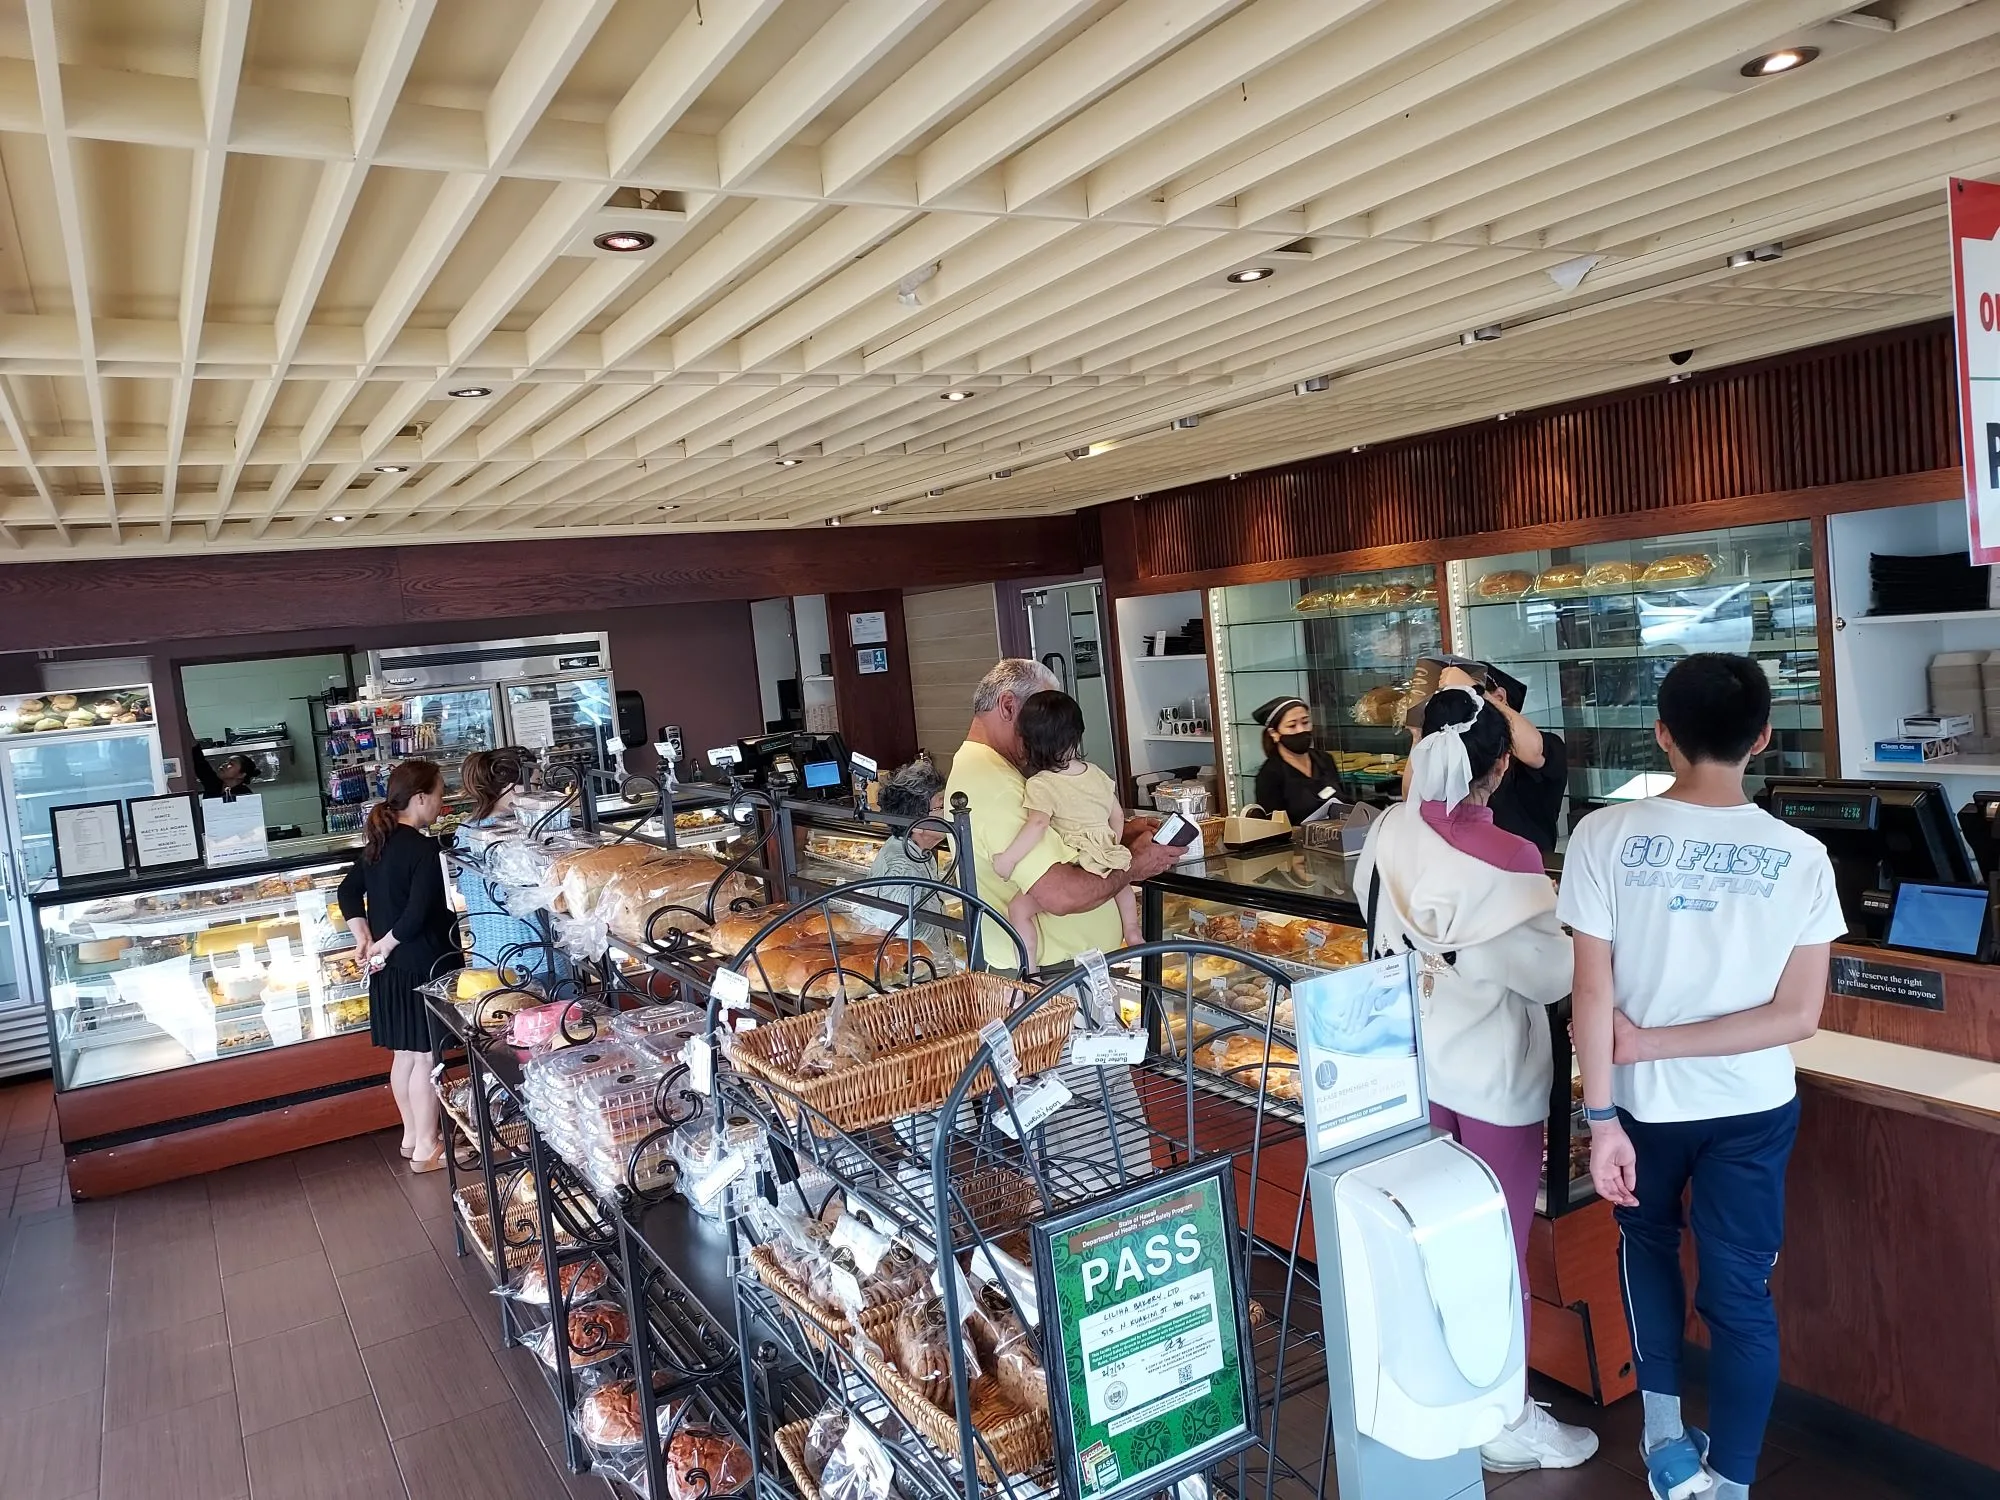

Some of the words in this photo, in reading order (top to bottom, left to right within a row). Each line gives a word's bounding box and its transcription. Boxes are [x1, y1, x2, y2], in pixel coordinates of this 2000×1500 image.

[1620, 835, 1674, 867] GO
[1676, 840, 1792, 880] FAST
[1625, 870, 1704, 890] HAVE
[1709, 876, 1775, 898] FUN
[1848, 968, 1860, 977] We
[1862, 971, 1888, 982] reserve
[1890, 975, 1902, 983] the
[1904, 976, 1922, 987] right
[1846, 979, 1868, 988] refuse
[1870, 984, 1896, 992] service
[1908, 990, 1936, 999] anyone
[1317, 1090, 1338, 1103] PLEASE
[1339, 1084, 1368, 1096] REMEMBER
[1046, 1100, 1061, 1113] Lady
[1024, 1112, 1046, 1128] Fingers
[1082, 1232, 1113, 1247] Department
[1120, 1223, 1136, 1233] Health
[1141, 1216, 1154, 1226] Food
[1155, 1212, 1170, 1221] Safety
[1171, 1203, 1192, 1214] Program
[1118, 1219, 1132, 1227] State
[1139, 1209, 1156, 1220] Hawaii
[1081, 1224, 1200, 1303] PASS
[1103, 1306, 1128, 1320] LILIHA
[1167, 1286, 1179, 1297] LTD
[1098, 1459, 1114, 1472] PASS
